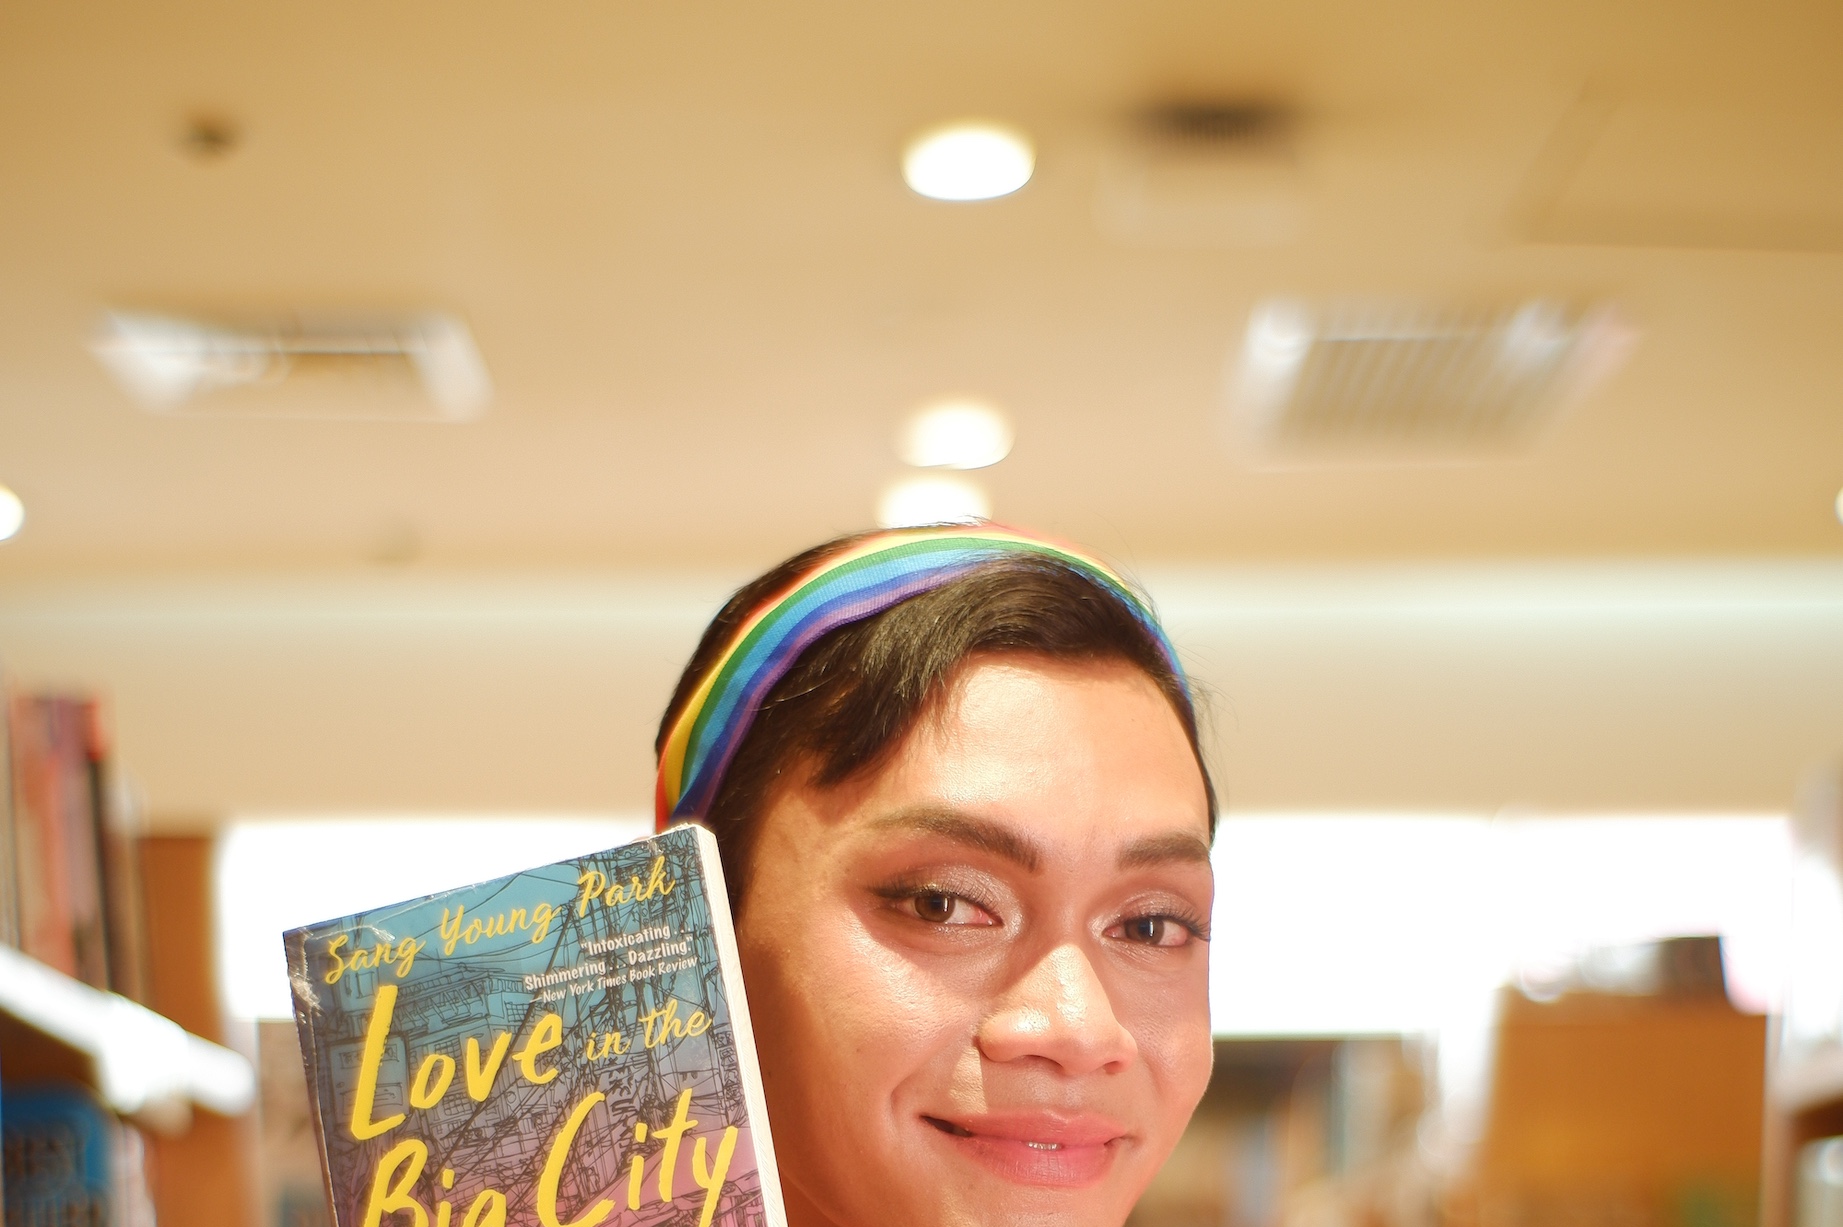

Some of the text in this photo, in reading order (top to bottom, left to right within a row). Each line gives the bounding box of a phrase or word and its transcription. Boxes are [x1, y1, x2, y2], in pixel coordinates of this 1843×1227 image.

[325, 856, 676, 985] Sang Young Park
[525, 960, 606, 991] Shimmering
[569, 978, 595, 997] York
[598, 973, 627, 989] Times
[629, 965, 656, 983] Book
[658, 956, 698, 975] Review
[351, 984, 712, 1140] Love in the
